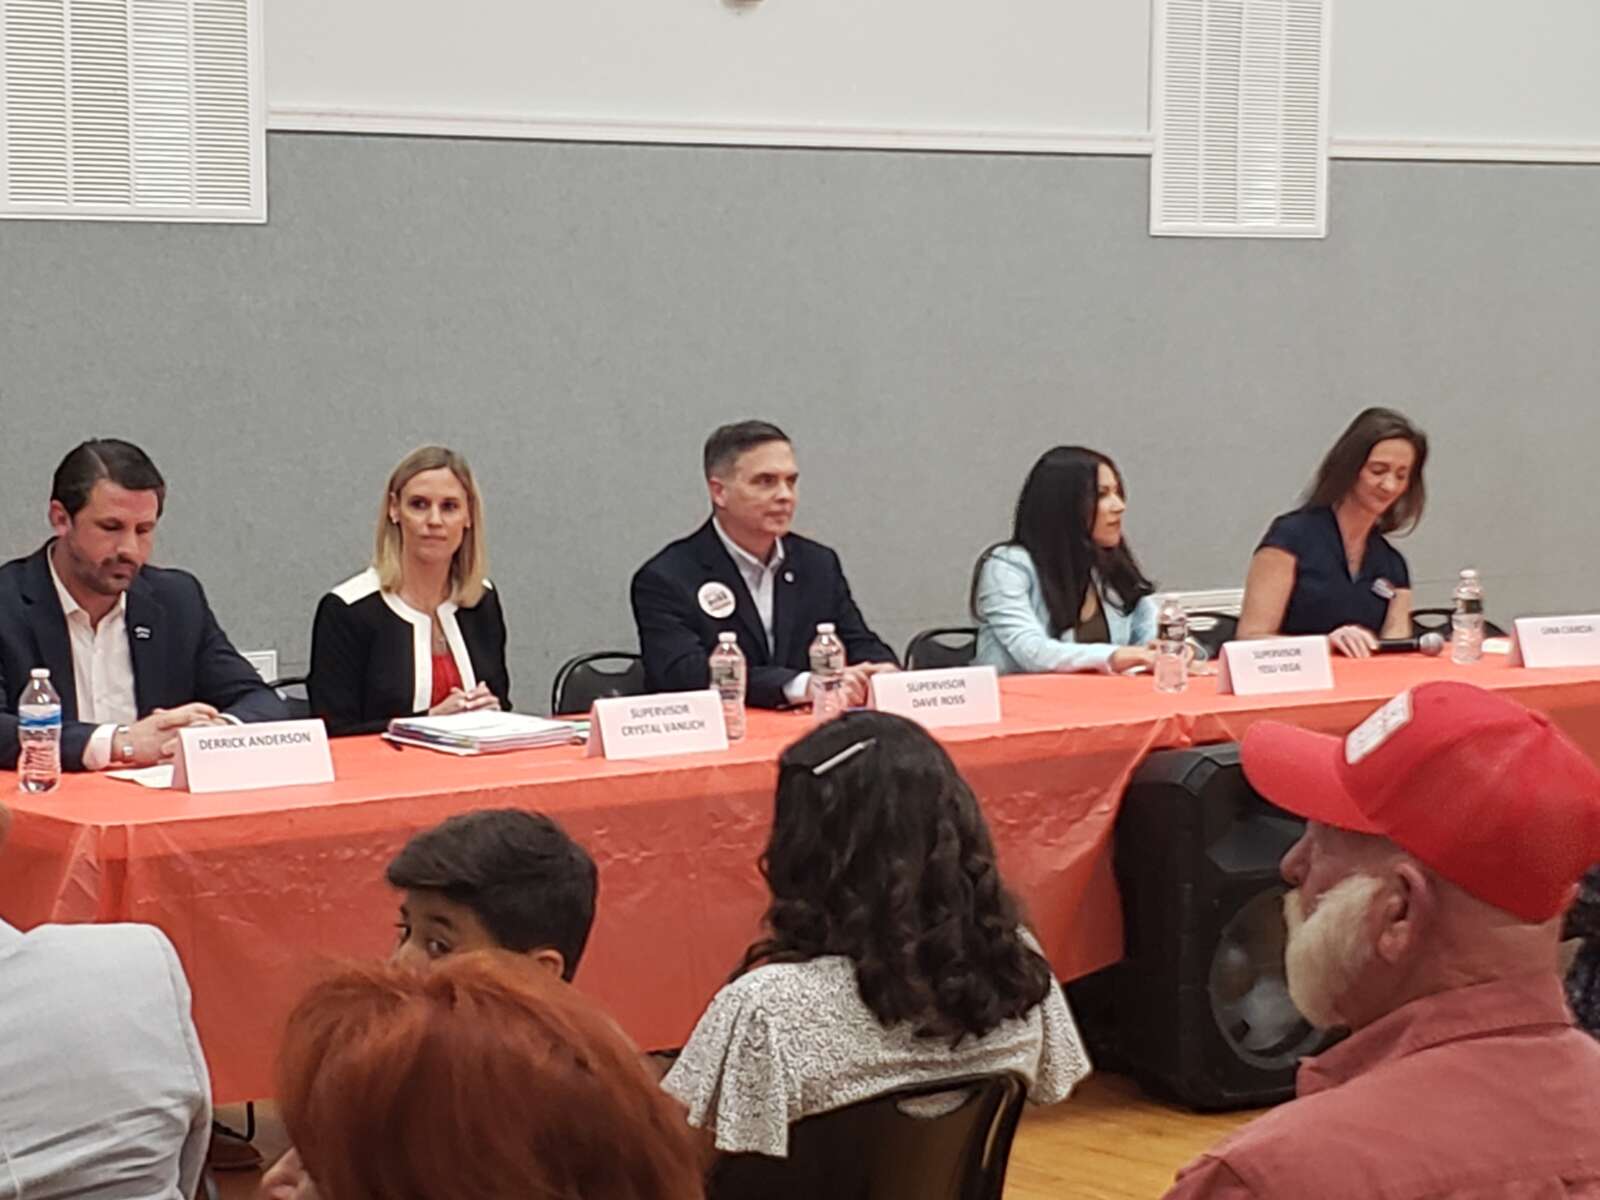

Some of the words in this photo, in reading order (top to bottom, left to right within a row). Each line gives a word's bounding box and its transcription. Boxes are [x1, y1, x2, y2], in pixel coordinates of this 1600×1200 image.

[906, 679, 966, 693] SUPERVISOR
[912, 697, 938, 708] DAVE
[941, 695, 966, 706] ROSS
[630, 704, 690, 719] SUPERVISOR
[621, 724, 662, 737] CRYSTAL
[199, 737, 246, 750] DERRICK
[249, 732, 312, 747] ANDERSON
